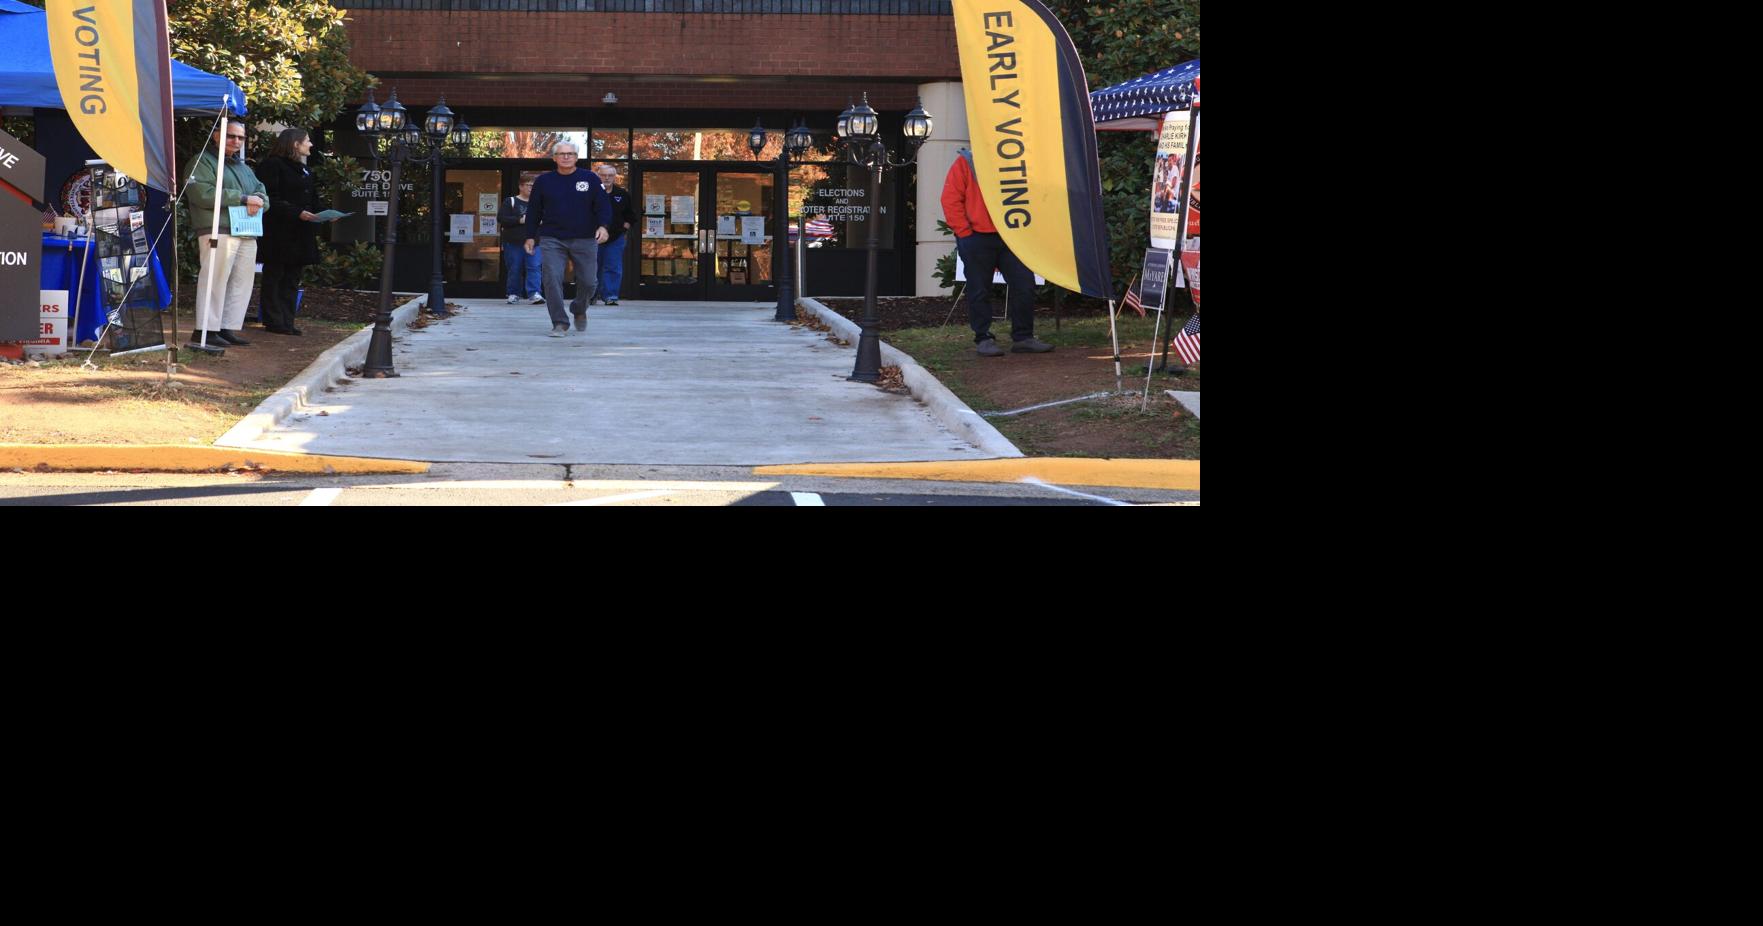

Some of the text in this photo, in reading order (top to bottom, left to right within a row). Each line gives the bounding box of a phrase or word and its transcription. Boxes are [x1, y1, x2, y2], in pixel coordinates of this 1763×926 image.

[72, 6, 107, 115] VOTING
[983, 11, 1032, 229] EARLY VOTING
[0, 146, 19, 169] VE
[363, 170, 391, 182] 750
[382, 182, 414, 191] DIVE
[819, 189, 865, 197] ELECTIONS
[827, 206, 887, 214] REGISTRATN
[40, 304, 60, 313] RS
